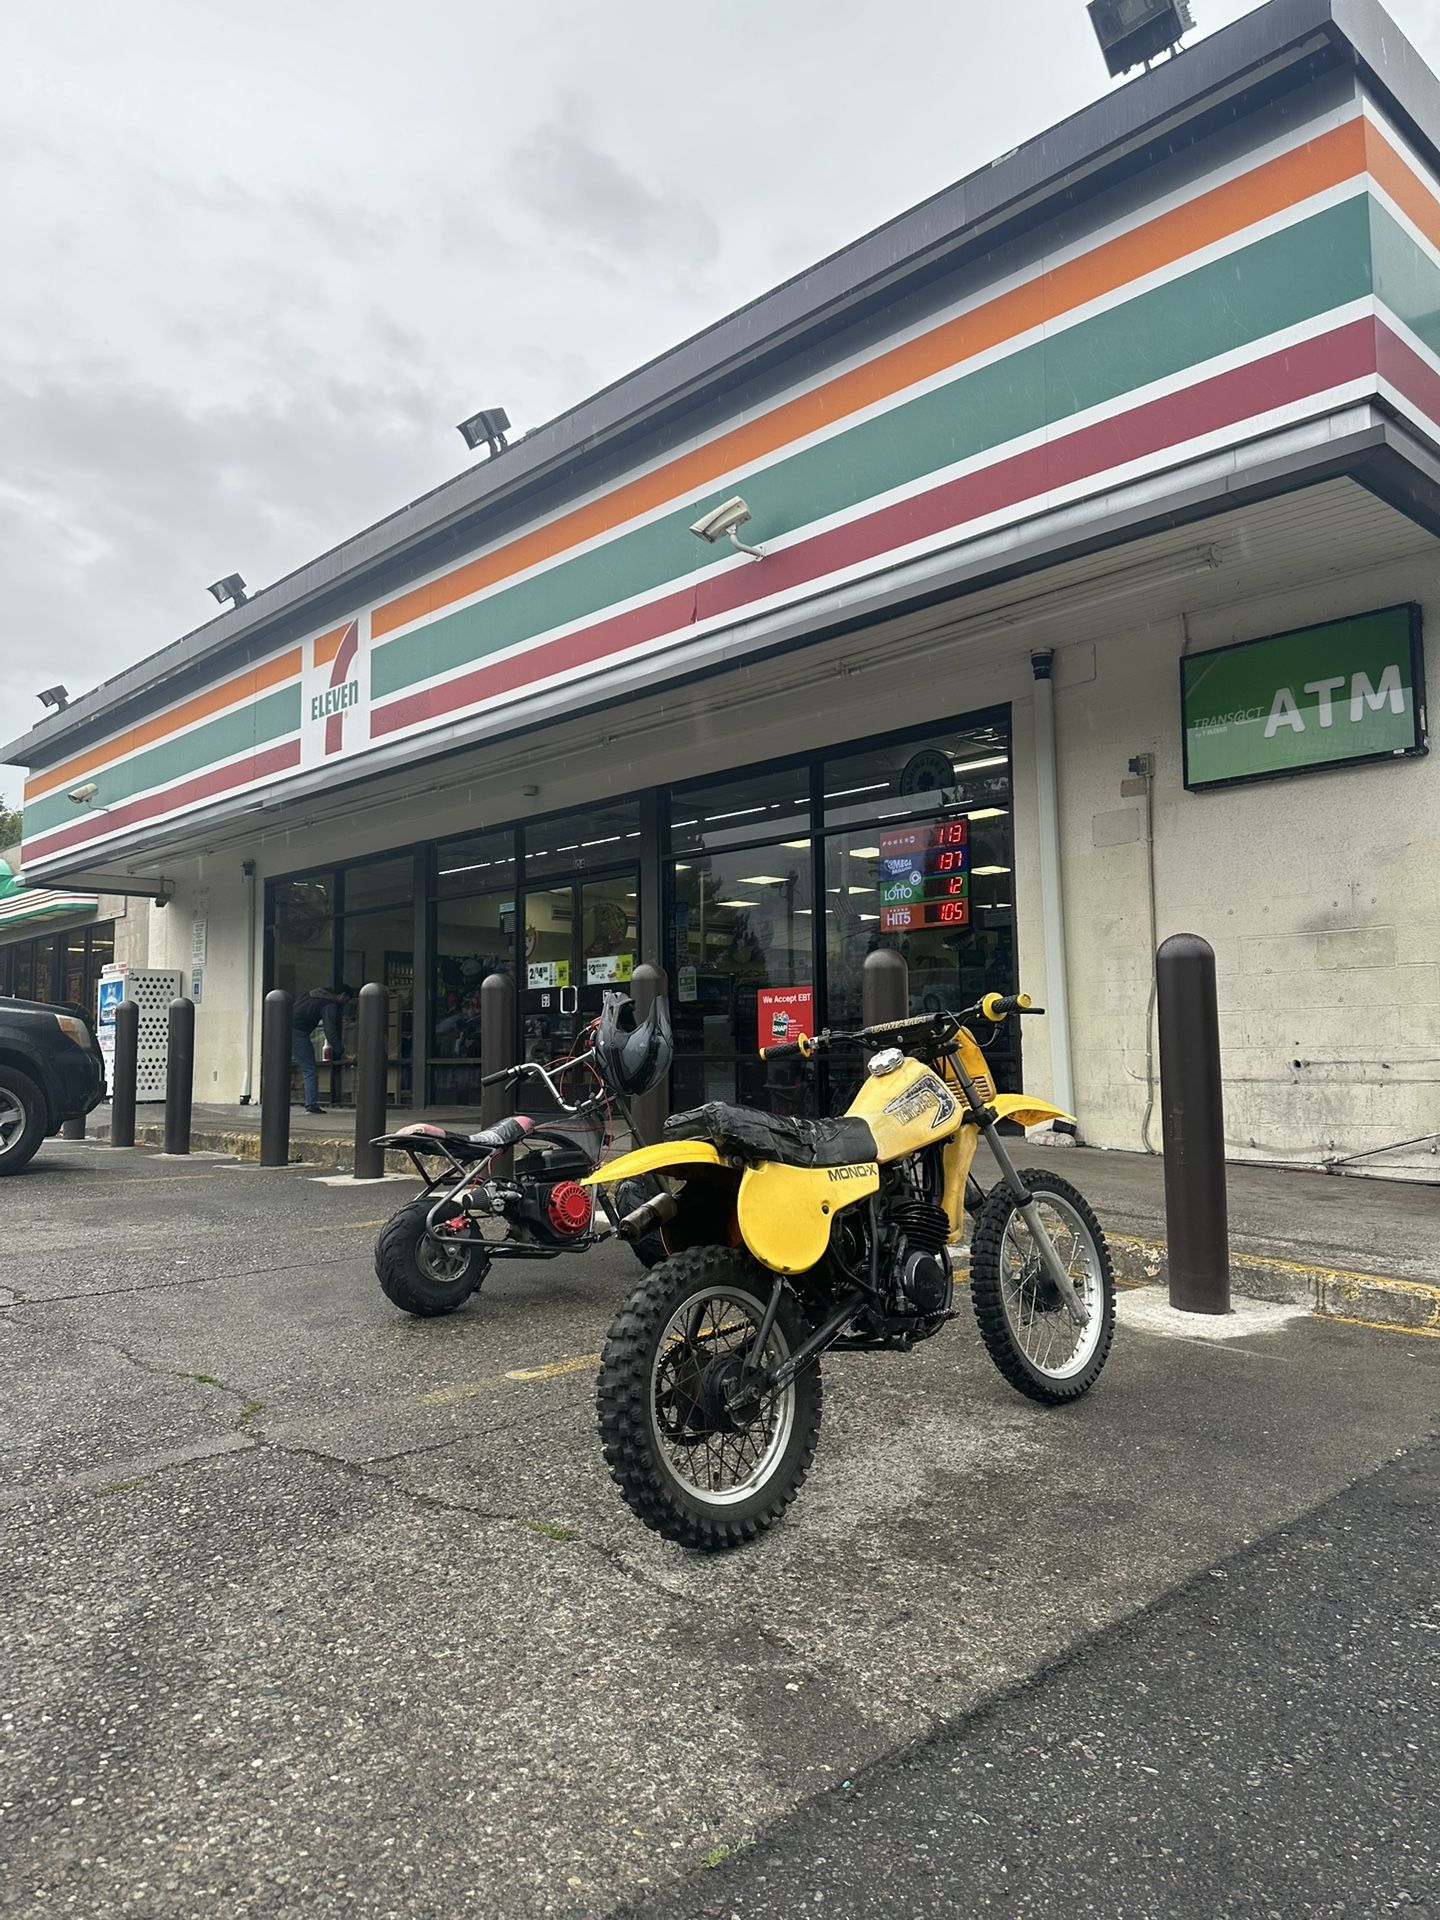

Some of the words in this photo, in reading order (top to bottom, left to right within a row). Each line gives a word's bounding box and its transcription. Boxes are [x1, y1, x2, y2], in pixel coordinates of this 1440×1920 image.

[1263, 664, 1406, 739] ATM
[940, 850, 963, 870] 137
[884, 885, 913, 901] LOTTO
[940, 902, 963, 920] 105
[762, 995, 773, 1004] We
[773, 994, 797, 1005] Accept
[797, 992, 811, 1002] EBT
